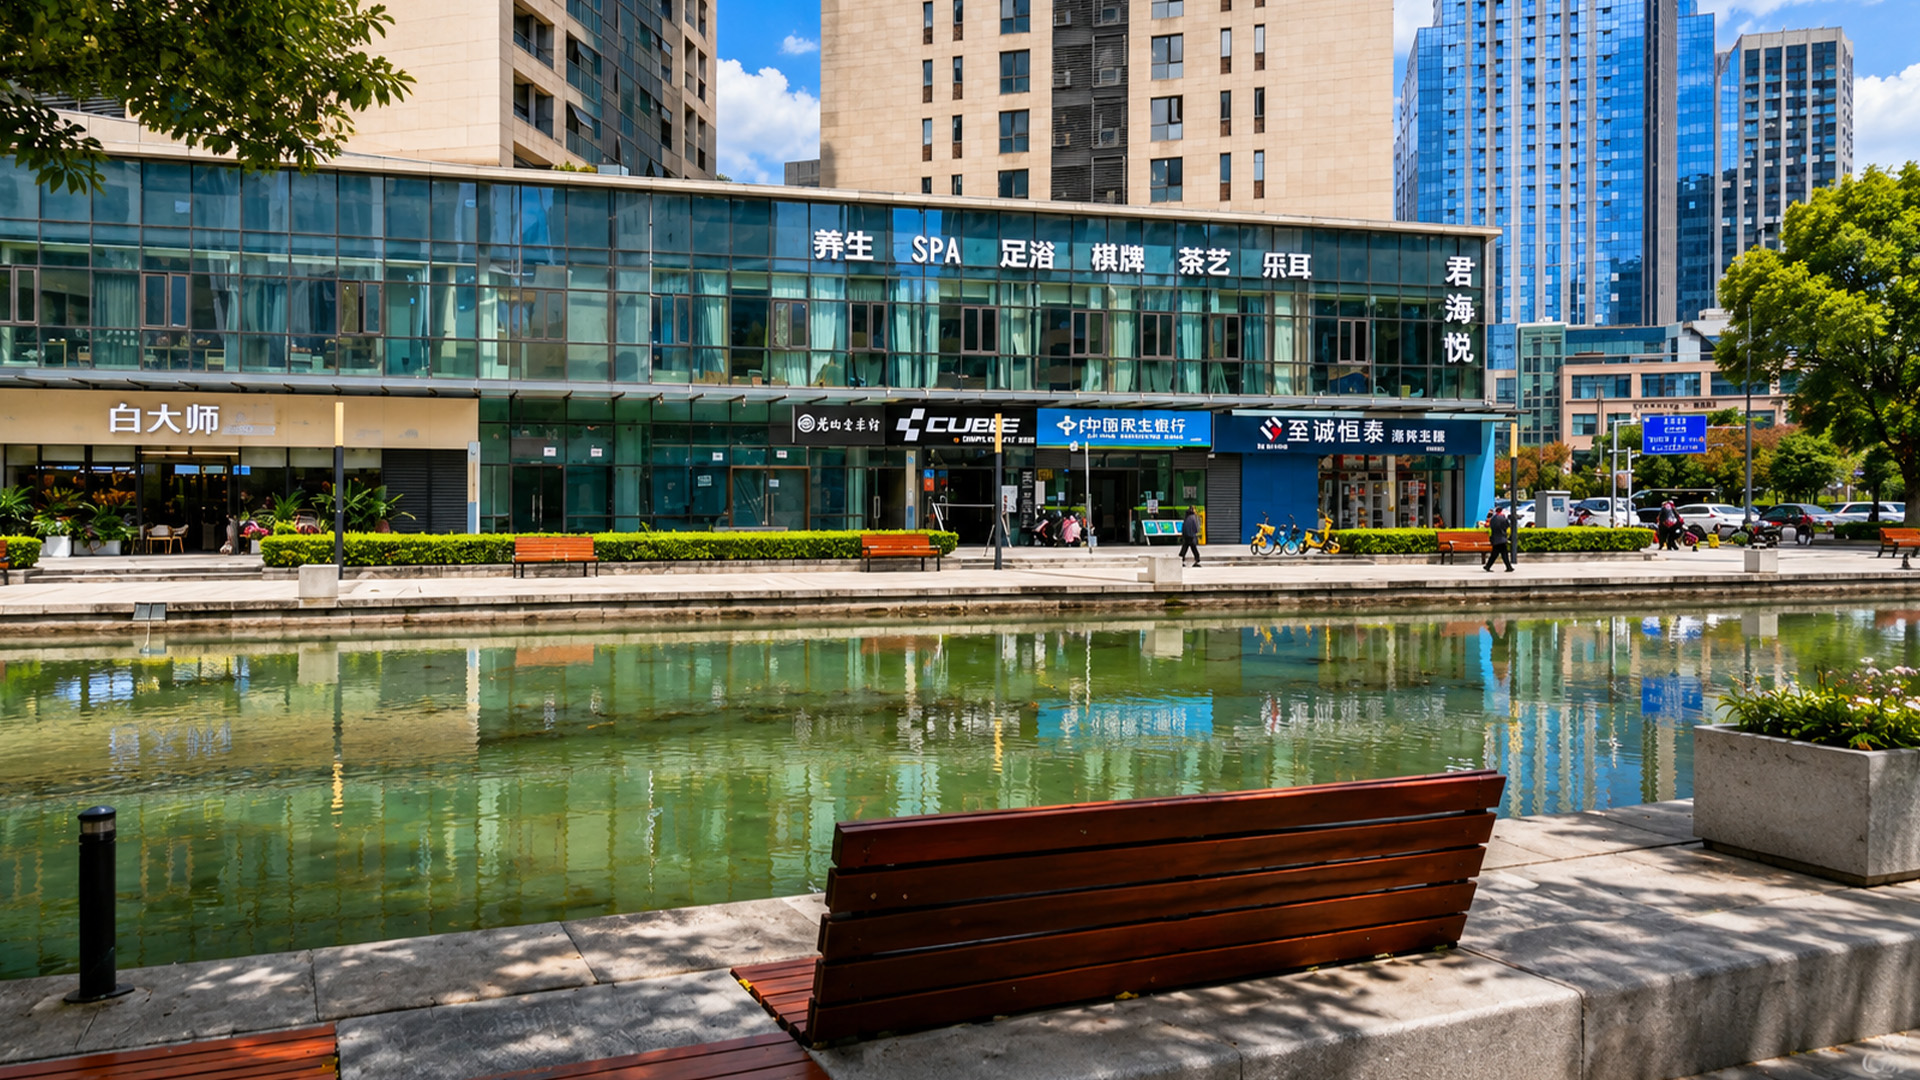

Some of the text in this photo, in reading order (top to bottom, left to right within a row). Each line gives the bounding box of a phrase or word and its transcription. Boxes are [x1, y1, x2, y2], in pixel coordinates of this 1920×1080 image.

[813, 229, 874, 261] 养生
[911, 235, 961, 264] SPA
[1000, 239, 1055, 269] 足浴
[1091, 243, 1145, 273] 棋牌
[1178, 247, 1231, 276] 茶艺
[1444, 256, 1476, 363] 君海悦
[109, 402, 220, 435] 白大师
[1287, 419, 1384, 443] 至诚恒泰
